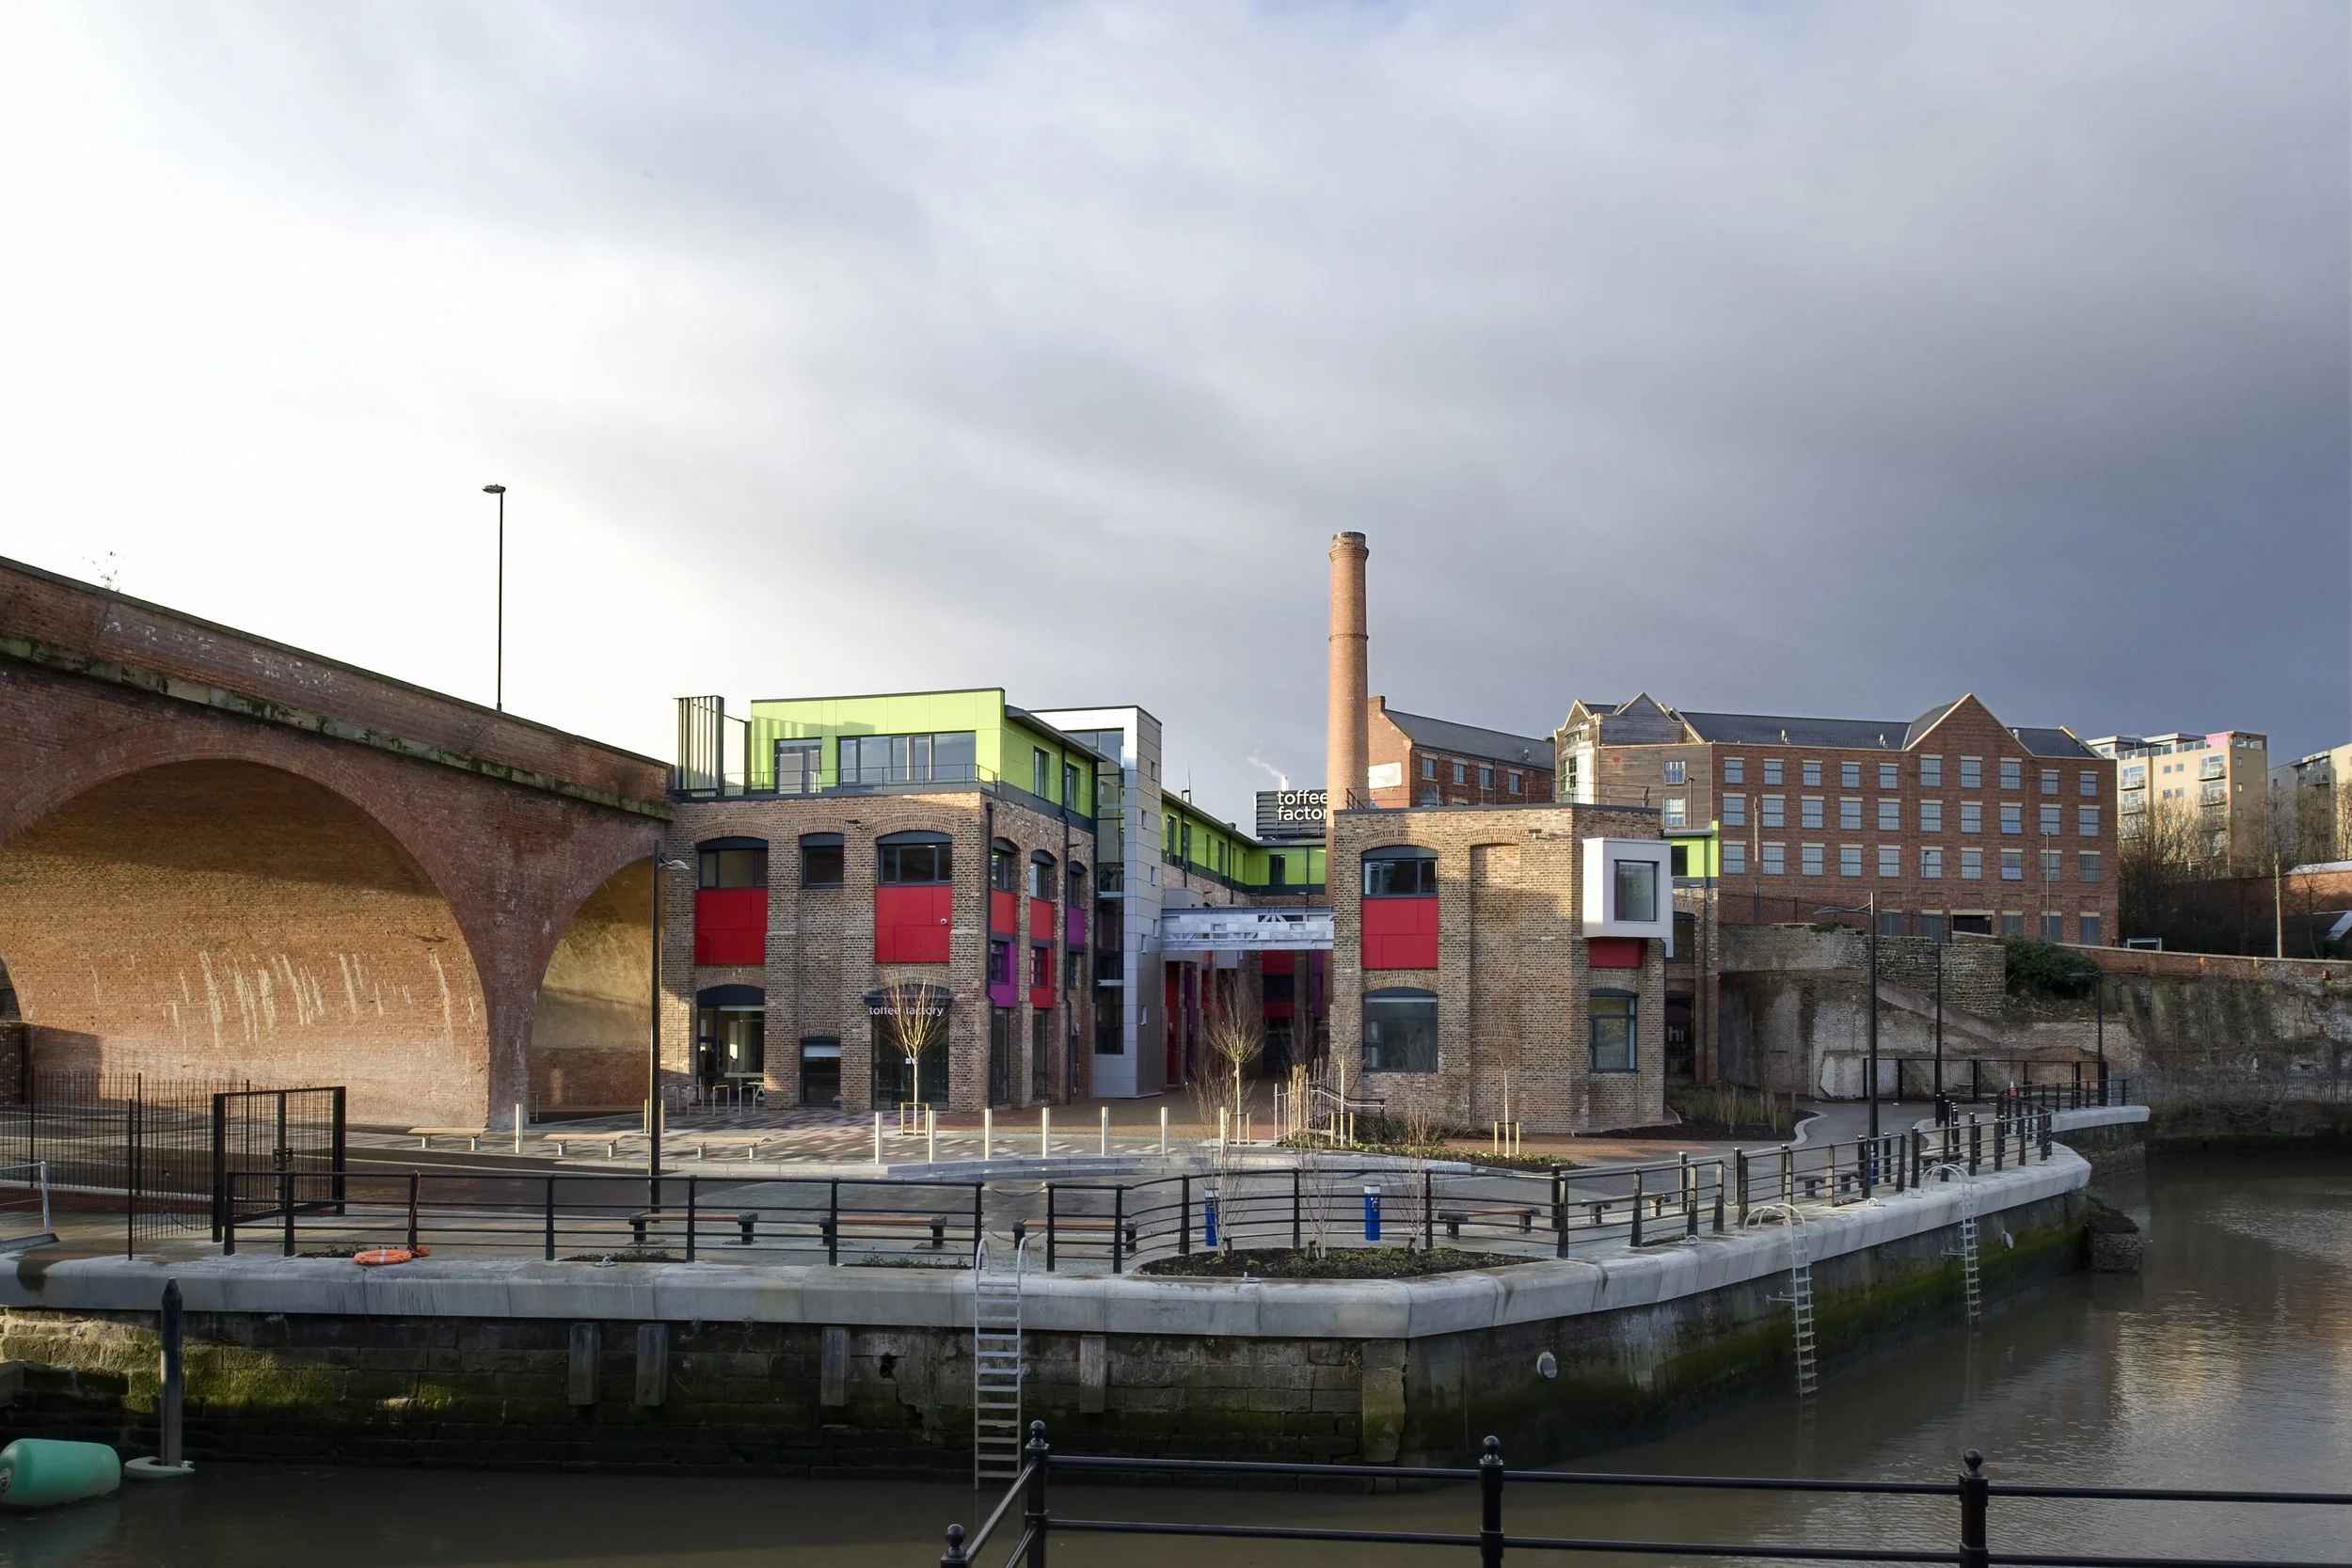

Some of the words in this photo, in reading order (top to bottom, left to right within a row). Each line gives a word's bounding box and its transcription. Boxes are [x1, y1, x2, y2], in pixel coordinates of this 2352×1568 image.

[1277, 789, 1327, 805] toffee
[1277, 805, 1327, 820] factor
[868, 1006, 900, 1015] toffee
